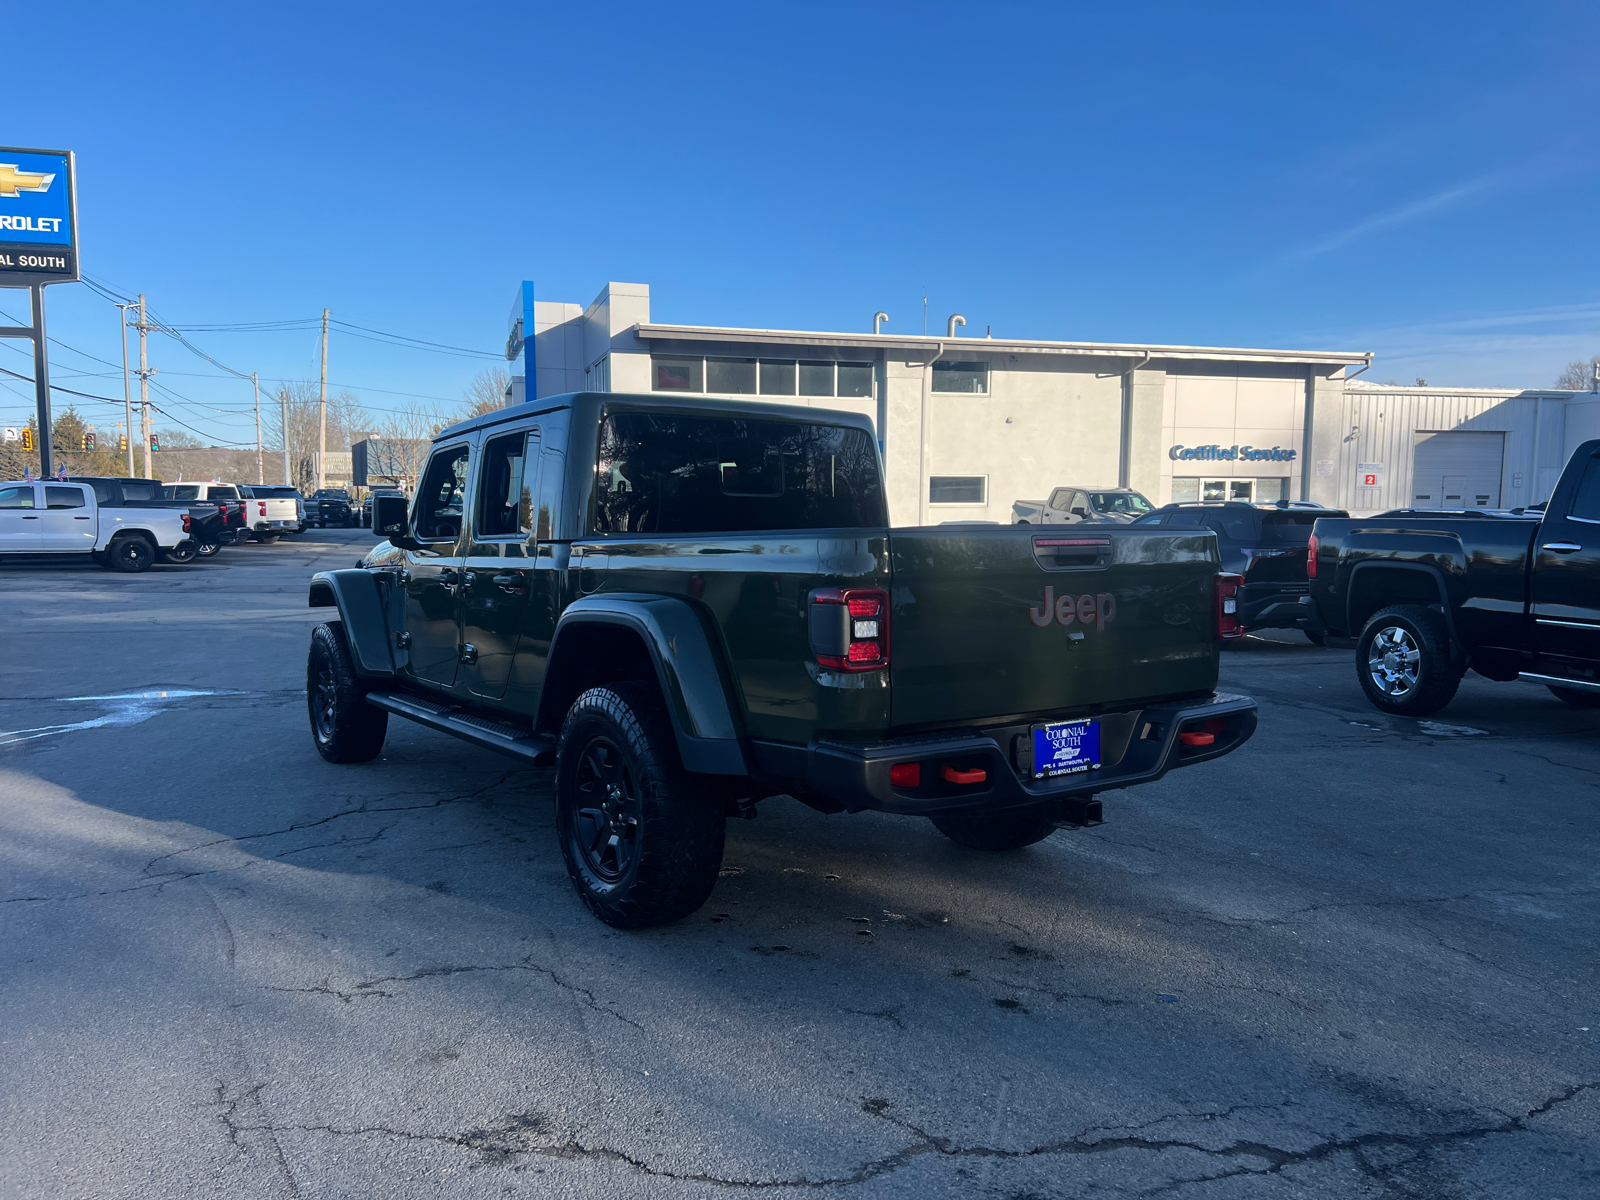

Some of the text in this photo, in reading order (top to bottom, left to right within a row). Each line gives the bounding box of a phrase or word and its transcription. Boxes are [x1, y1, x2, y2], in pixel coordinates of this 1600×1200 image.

[19, 255, 65, 268] SOUTH
[1170, 445, 1297, 461] Certified Service
[1367, 476, 1374, 484] 2
[1030, 586, 1116, 631] Jeep
[1046, 726, 1087, 740] COLONIAL
[1052, 736, 1080, 749] SOUTH
[1056, 749, 1078, 757] CHEVROLET
[1048, 768, 1071, 776] COLONIAL
